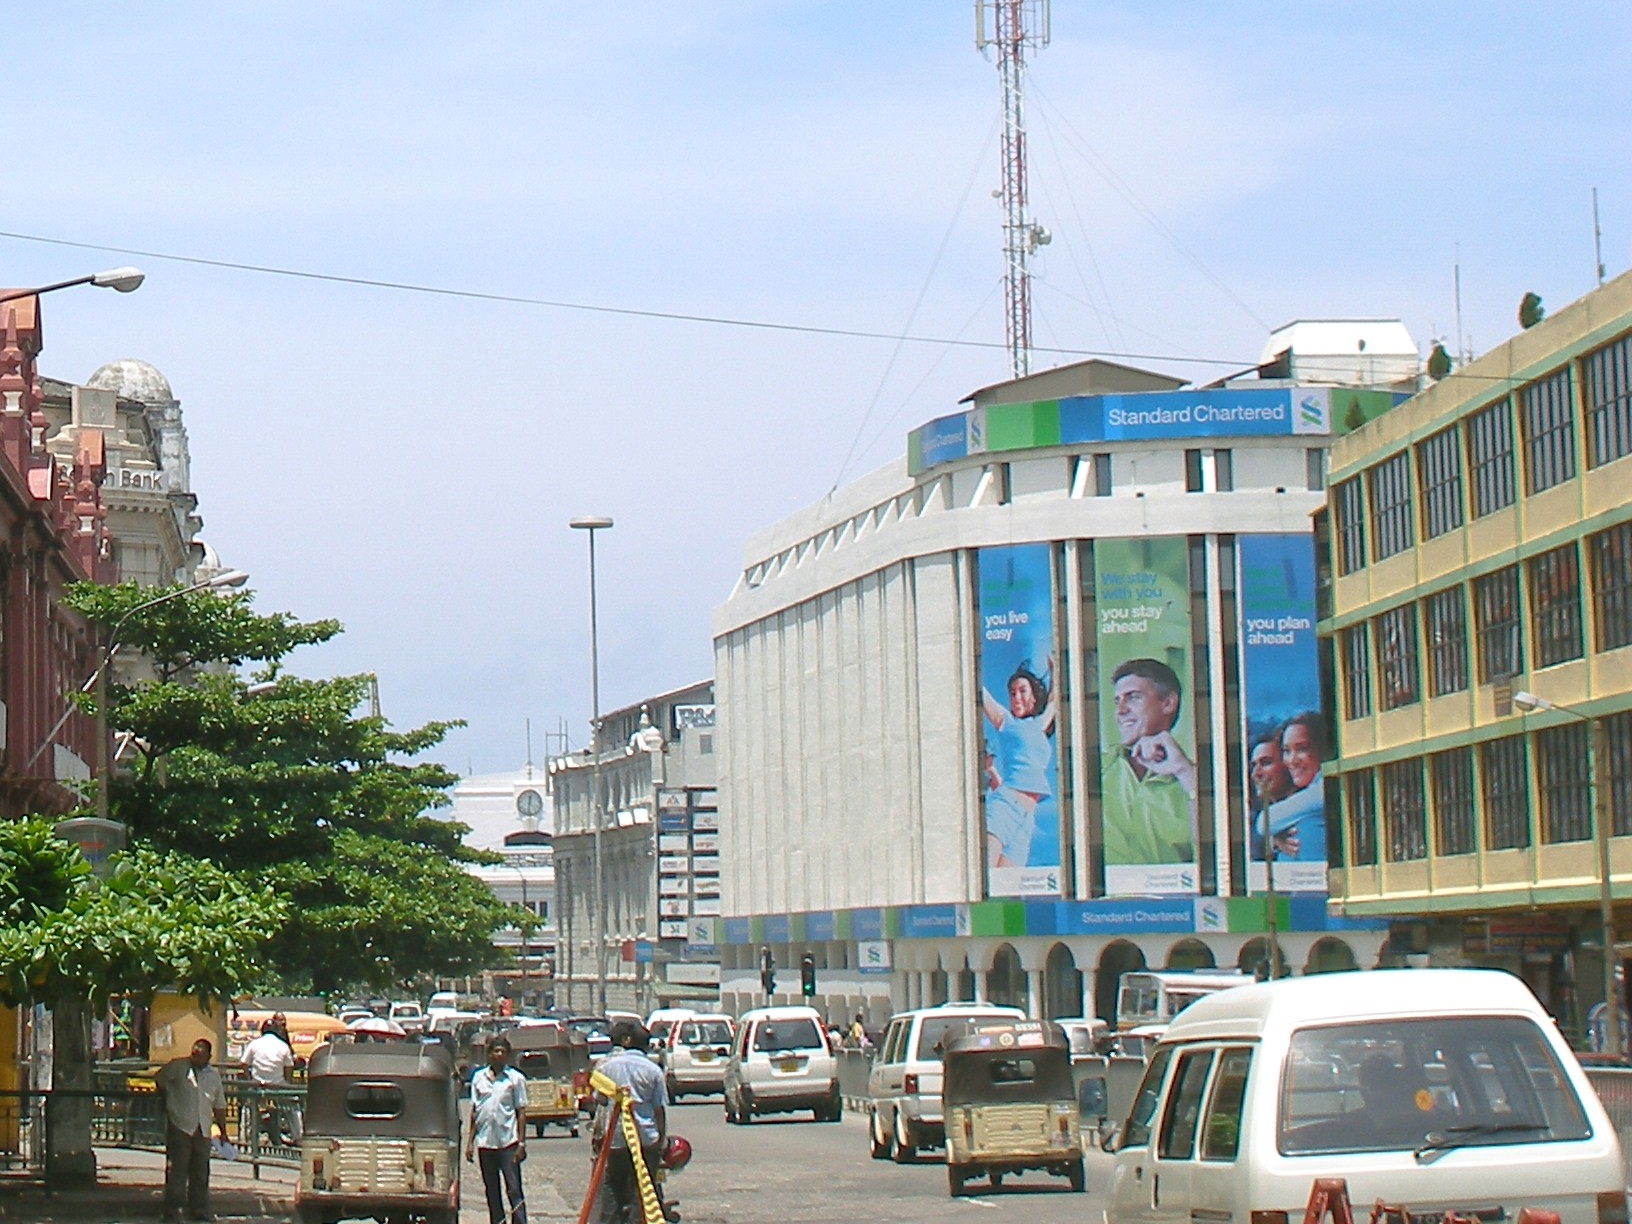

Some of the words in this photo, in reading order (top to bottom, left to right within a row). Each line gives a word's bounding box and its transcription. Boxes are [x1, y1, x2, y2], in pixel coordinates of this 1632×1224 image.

[1108, 407, 1191, 426] Standard
[1193, 403, 1285, 422] Chartered
[120, 468, 163, 489] Bank
[1101, 573, 1123, 585] We
[1128, 572, 1157, 585] stay
[1135, 588, 1162, 601] you
[1101, 608, 1129, 622] you
[1131, 604, 1163, 619] stay
[985, 614, 1007, 629] you
[1102, 619, 1147, 633] ahead
[1246, 618, 1275, 632] you
[1277, 615, 1310, 632] plan
[985, 628, 1013, 642] easy
[1247, 630, 1295, 645] ahead
[1081, 911, 1133, 925] Standard
[1135, 909, 1191, 923] Chartered
